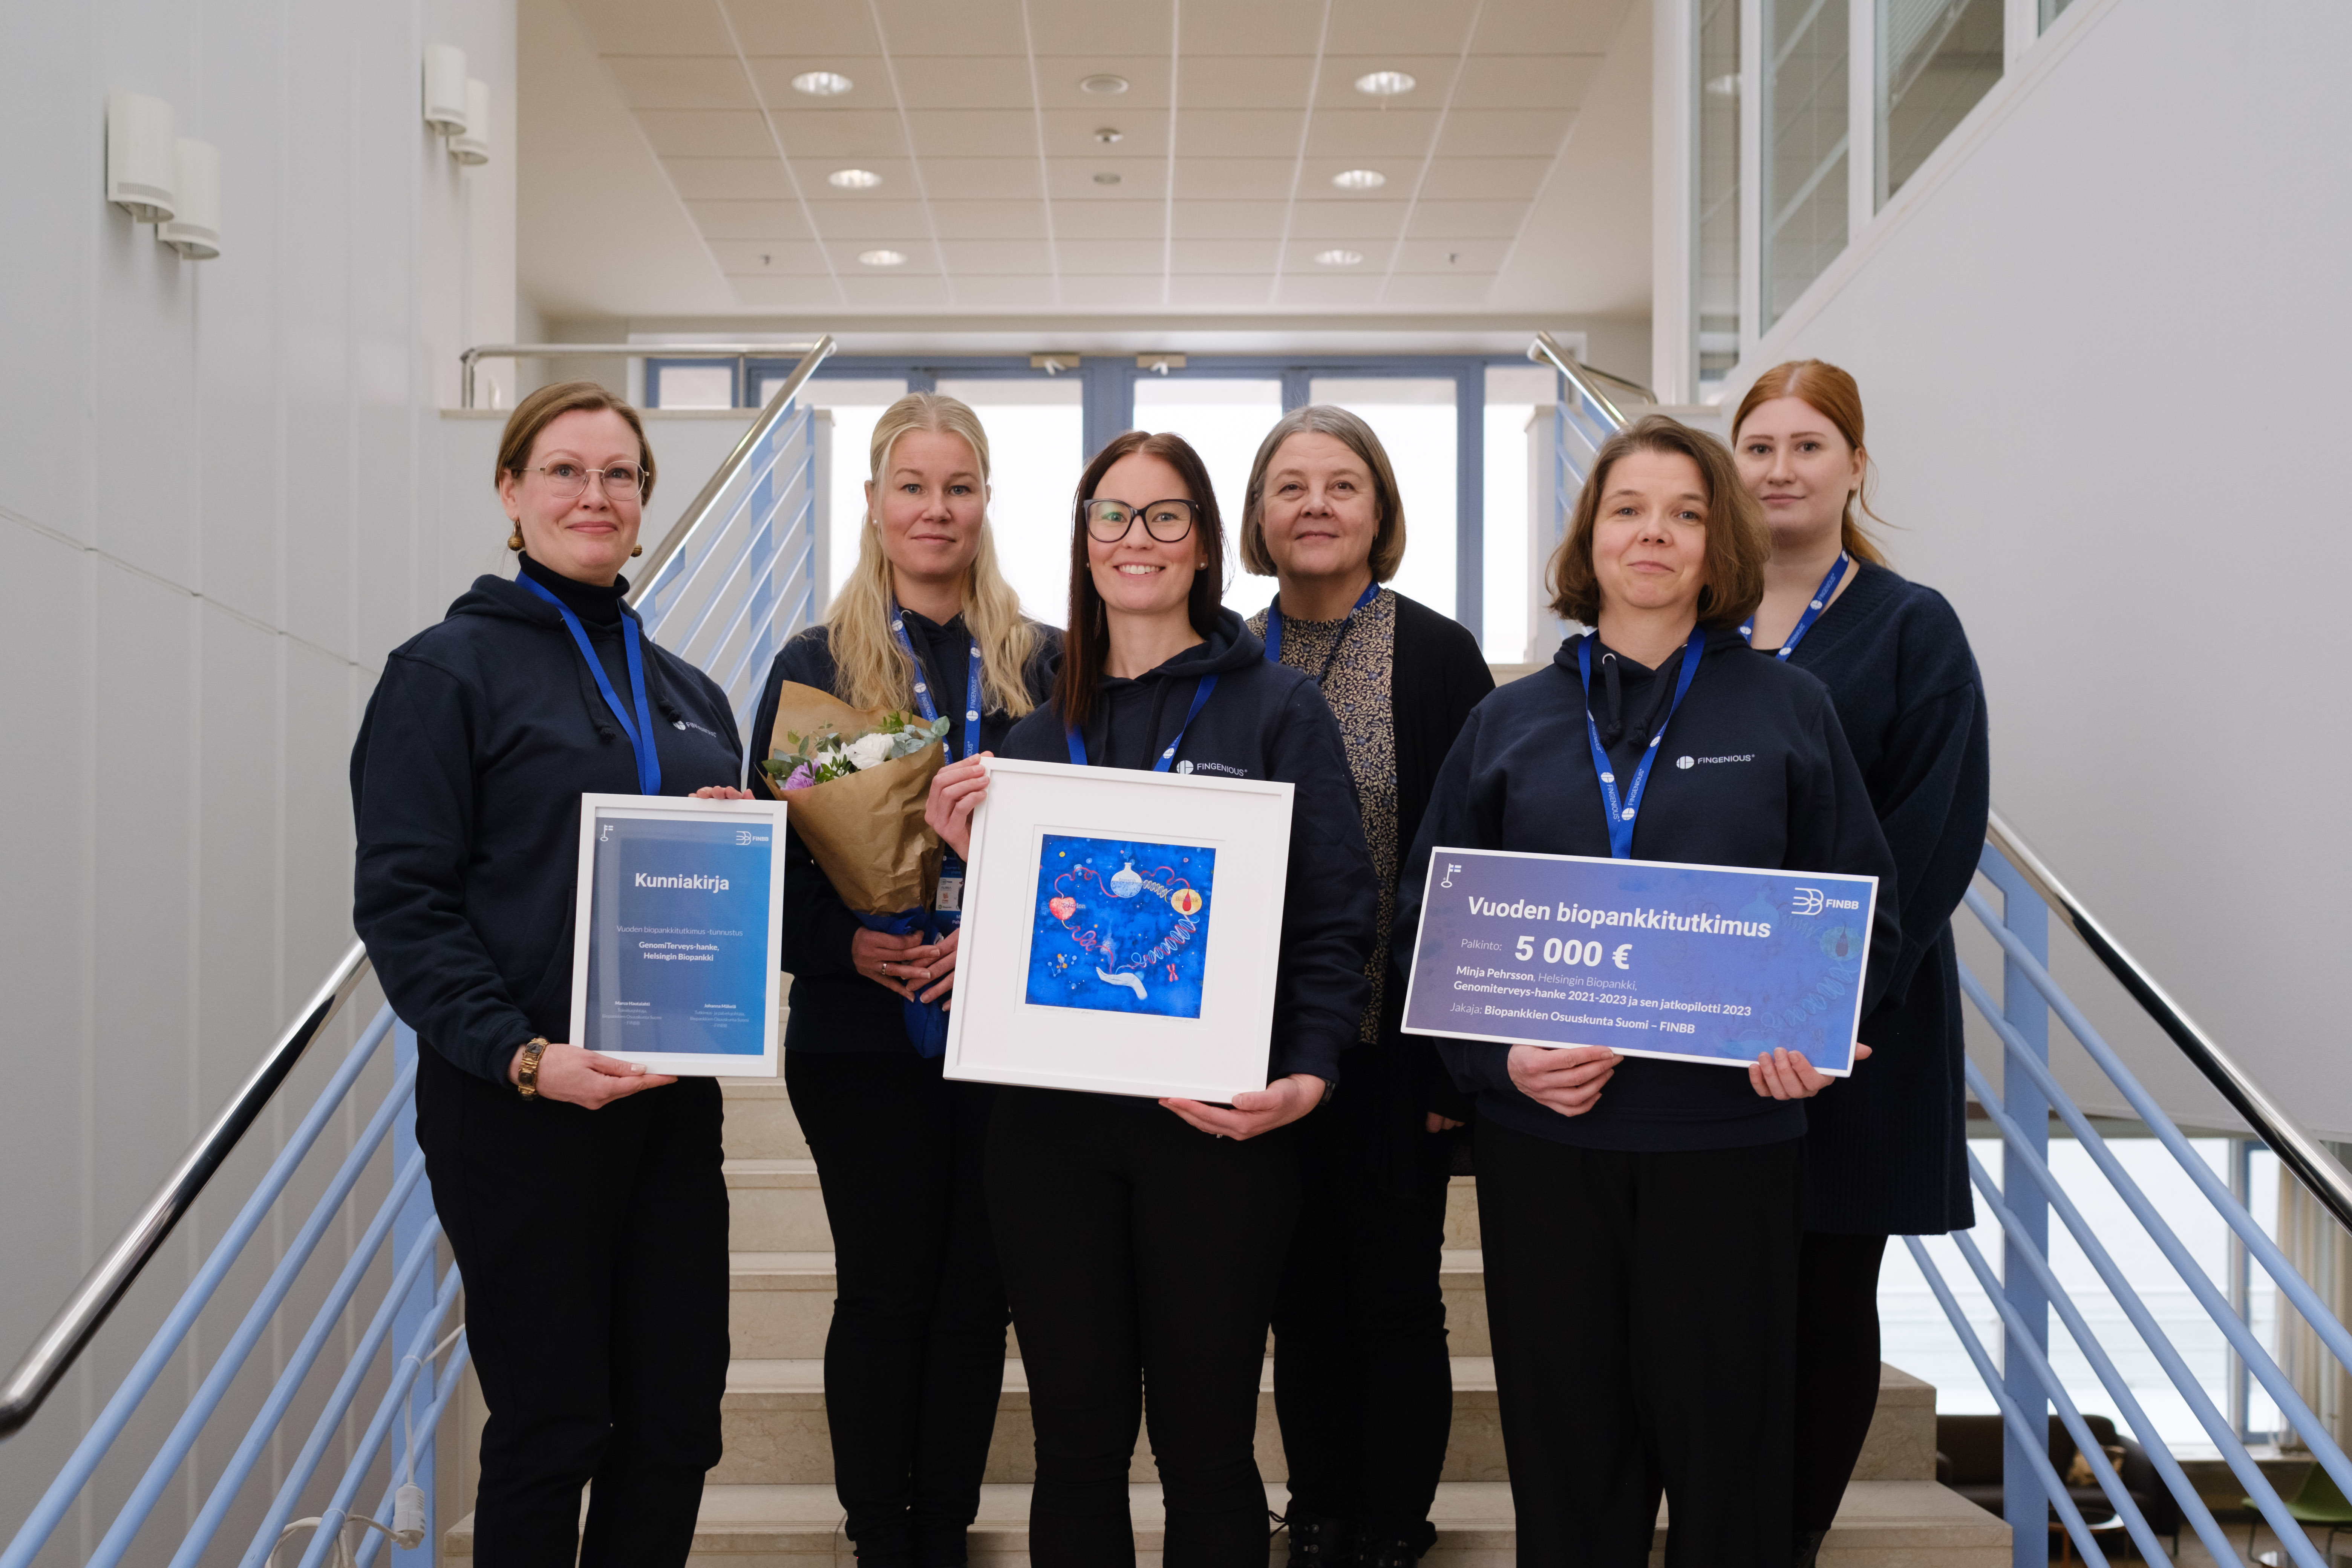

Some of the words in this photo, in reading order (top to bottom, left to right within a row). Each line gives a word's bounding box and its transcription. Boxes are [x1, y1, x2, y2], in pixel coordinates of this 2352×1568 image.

[635, 873, 729, 893] Kunniakirja
[1826, 899, 1859, 910] FINBB
[1468, 896, 1550, 920] Vuoden
[1557, 902, 1771, 938] biopankkitutkimus
[644, 926, 706, 935] biopankkitutkimus
[639, 942, 720, 951] GenomiTerveys-hanke,
[644, 952, 677, 961] Helsingin
[678, 953, 714, 962] Biopankki
[1461, 938, 1502, 951] Palkinto:
[1515, 935, 1535, 961] 5
[1543, 938, 1603, 967] 000
[1612, 944, 1632, 969] €
[1456, 966, 1485, 978] Minja
[1487, 968, 1536, 982] Pehrsson,
[1538, 972, 1583, 986] Helsingin
[1586, 977, 1637, 992] Biopankki,
[1453, 981, 1566, 999] Genomiterveys-hanke
[1568, 991, 1626, 1005] 2021-2023
[1627, 995, 1638, 1007] ja
[1640, 999, 1658, 1008] sen
[1659, 999, 1721, 1014] jatkopilotti
[1722, 1004, 1752, 1016] 2023
[1450, 1002, 1482, 1015] Jakaja:
[1484, 1005, 1548, 1020] Biopankkien
[1550, 1011, 1614, 1026] Osuuskunta
[1615, 1017, 1649, 1029] Suomi
[1660, 1021, 1695, 1034] FINBB
